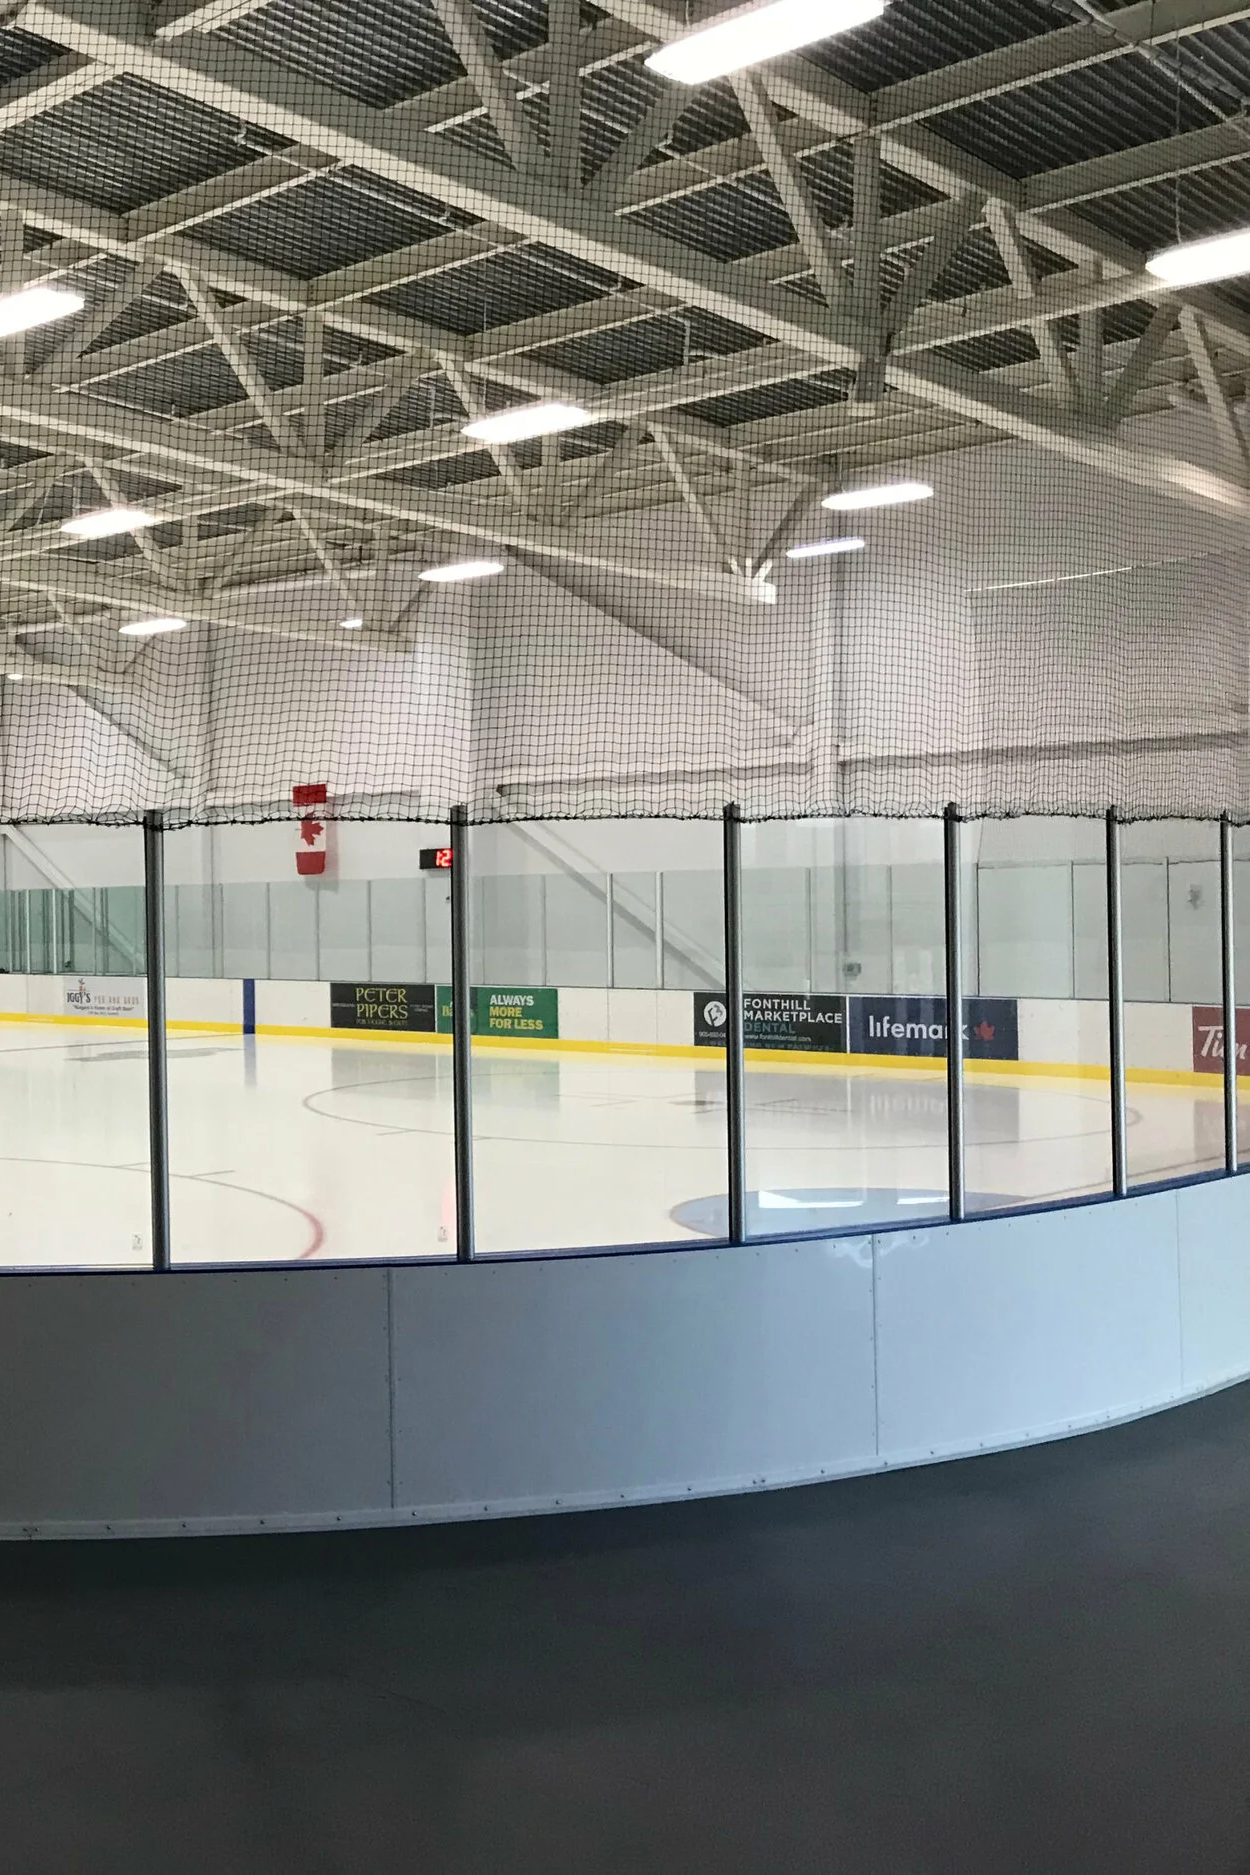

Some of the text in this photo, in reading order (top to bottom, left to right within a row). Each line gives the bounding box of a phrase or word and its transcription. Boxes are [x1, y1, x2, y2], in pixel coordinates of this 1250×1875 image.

[67, 992, 91, 1004] IGGY'S
[356, 987, 407, 1003] PETER
[490, 994, 534, 1006] ALWAYS
[356, 1003, 409, 1019] PIPERS
[743, 998, 811, 1011] FONTHILL
[490, 1006, 522, 1017] MORE
[743, 1010, 843, 1024] MARKETPLACE
[490, 1018, 543, 1030] FOR LESS
[744, 1021, 796, 1034] DENTAL
[868, 1015, 970, 1041] lifemak
